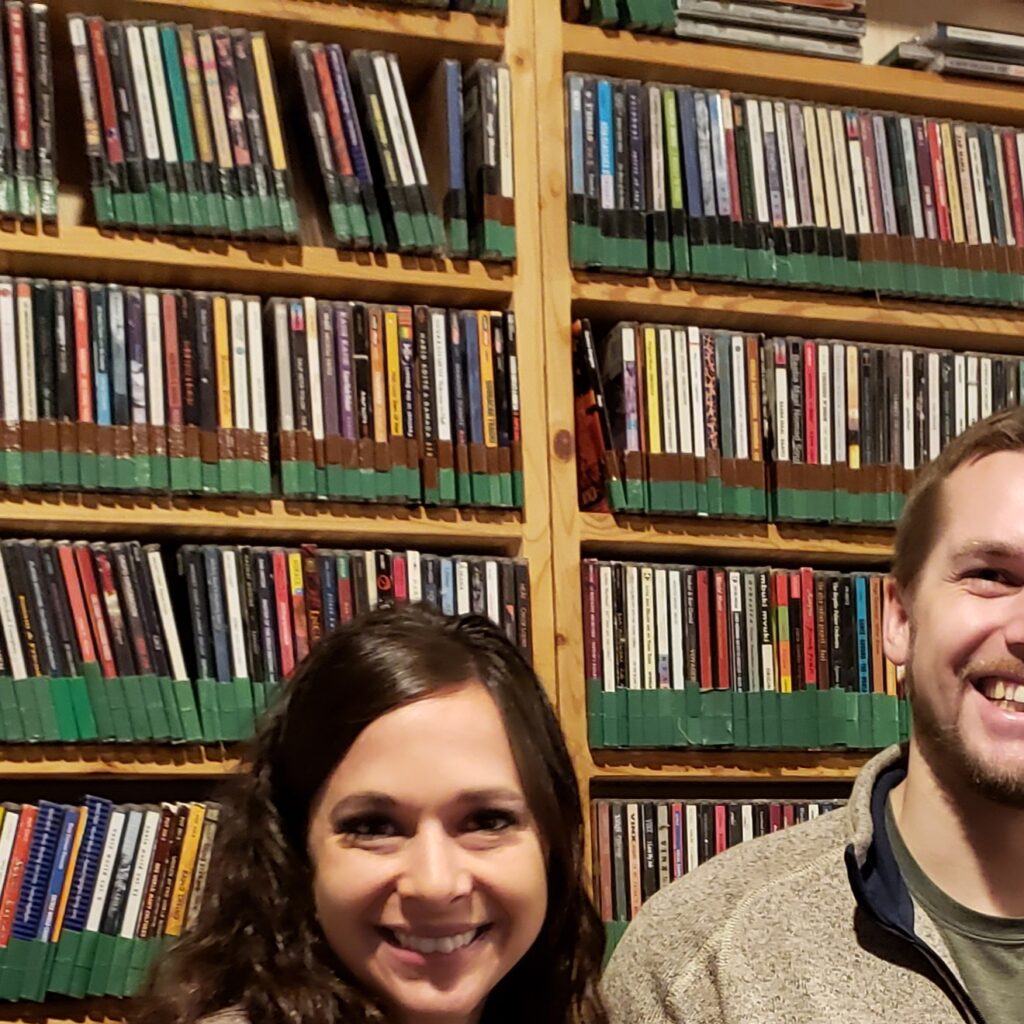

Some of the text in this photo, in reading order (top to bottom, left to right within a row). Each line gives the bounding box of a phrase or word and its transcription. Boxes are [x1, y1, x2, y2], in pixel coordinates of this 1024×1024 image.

[790, 354, 801, 383] Baaba
[792, 384, 802, 407] Maal
[793, 409, 802, 441] Nomad
[760, 574, 770, 642] mbuki mvuki
[102, 854, 113, 876] world
[136, 848, 146, 870] world
[660, 840, 668, 871] VINX
[98, 880, 107, 892] vol
